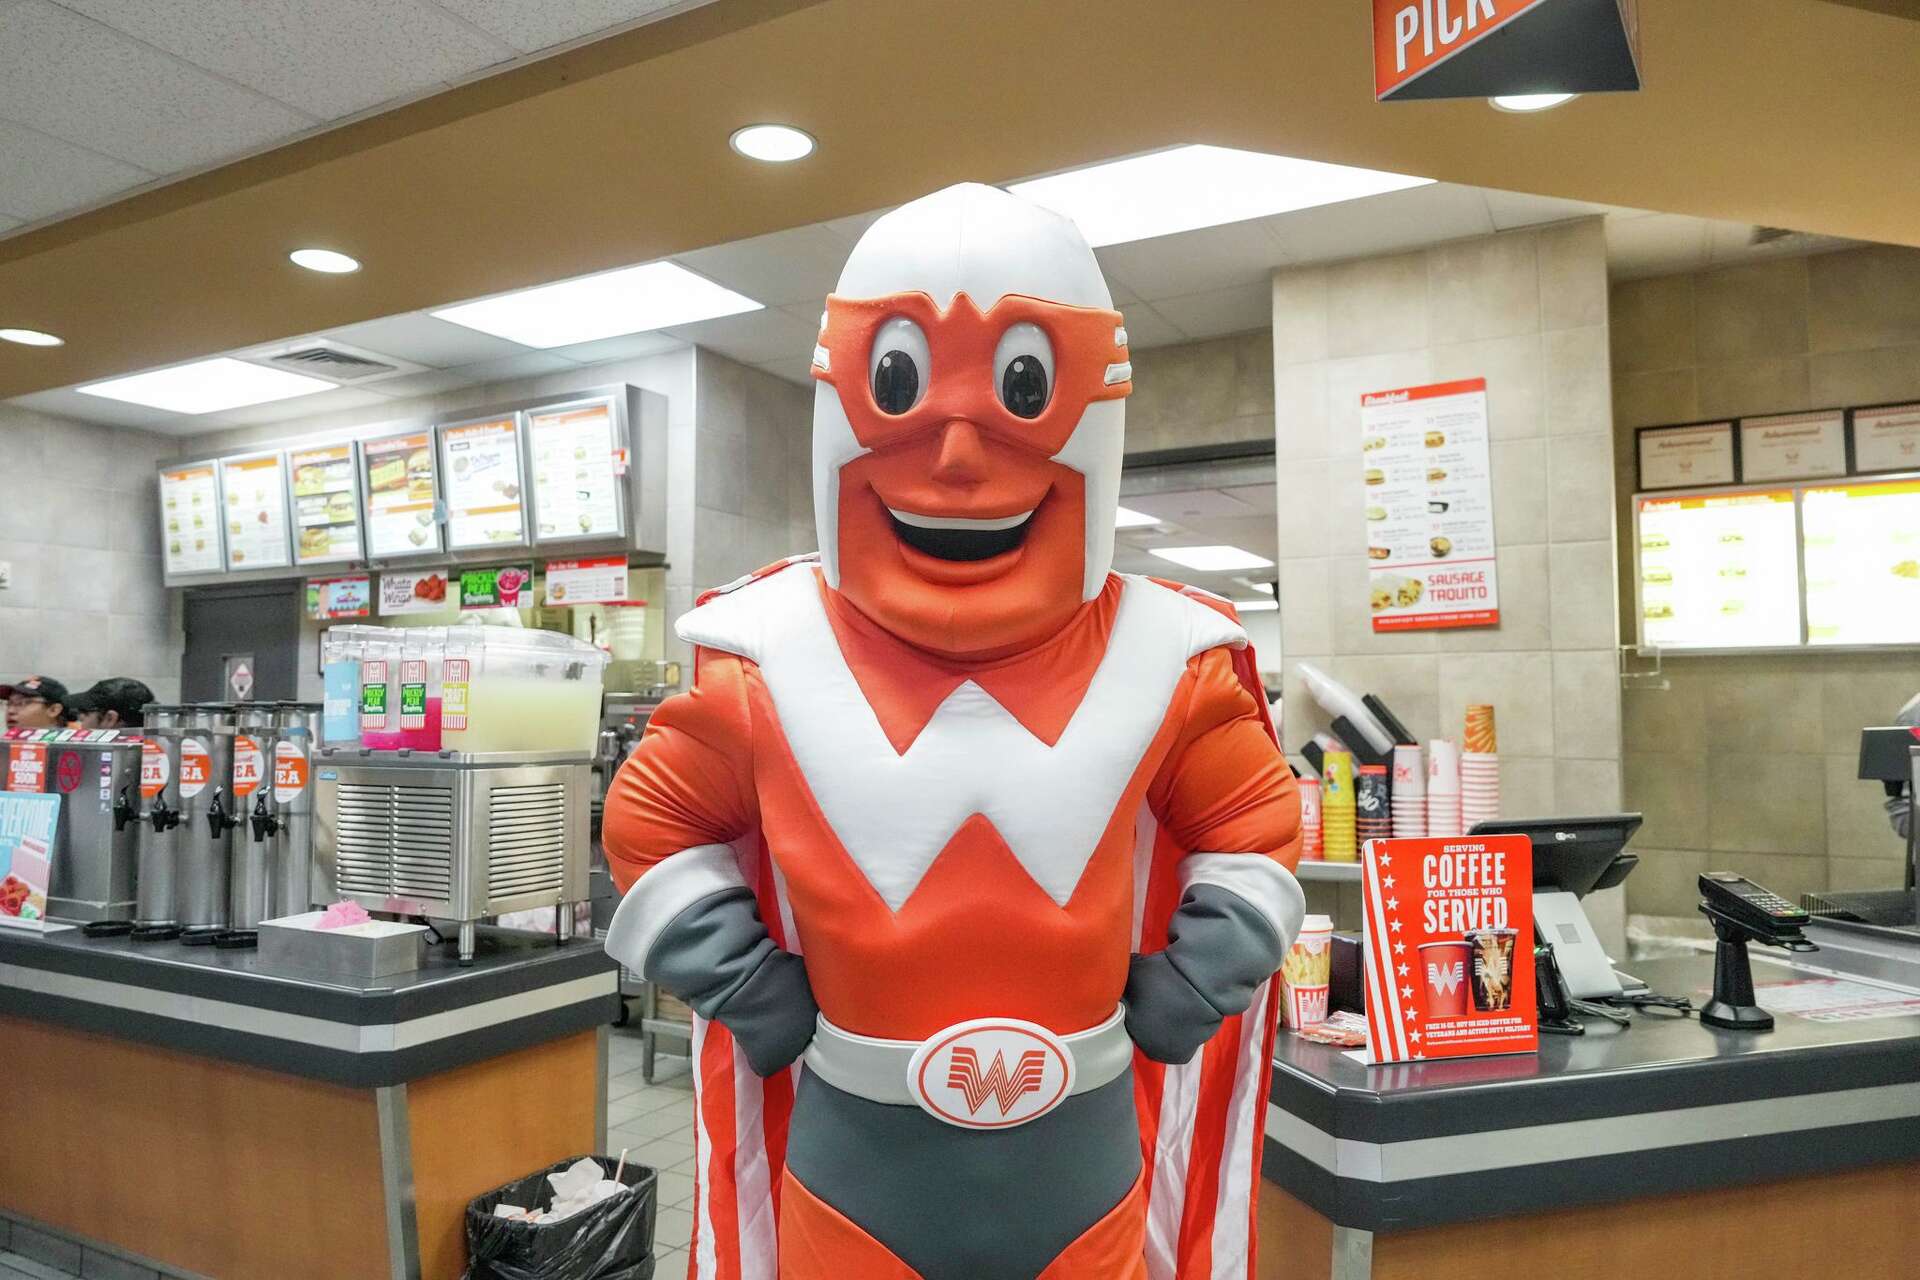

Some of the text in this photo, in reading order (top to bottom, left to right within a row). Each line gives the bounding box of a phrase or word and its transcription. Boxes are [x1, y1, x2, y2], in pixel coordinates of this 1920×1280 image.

[1428, 571, 1485, 586] SAUSAGE
[1429, 586, 1488, 602] TAQUITO
[143, 767, 162, 779] EA
[180, 767, 204, 780] EA
[235, 764, 257, 778] EA
[275, 771, 300, 784] EA
[1444, 844, 1485, 853] SERVING
[1423, 852, 1506, 888] COFFEE
[1427, 887, 1503, 898] FOR THOSE WHO
[1423, 896, 1508, 934] SERVED
[1425, 1023, 1440, 1031] FREE
[1489, 1018, 1511, 1026] COFFEE
[1425, 1030, 1456, 1038] VETERANS
[1468, 1027, 1489, 1035] ACTIVE
[1488, 1026, 1505, 1034] DUTY
[1505, 1025, 1531, 1033] MILITARY
